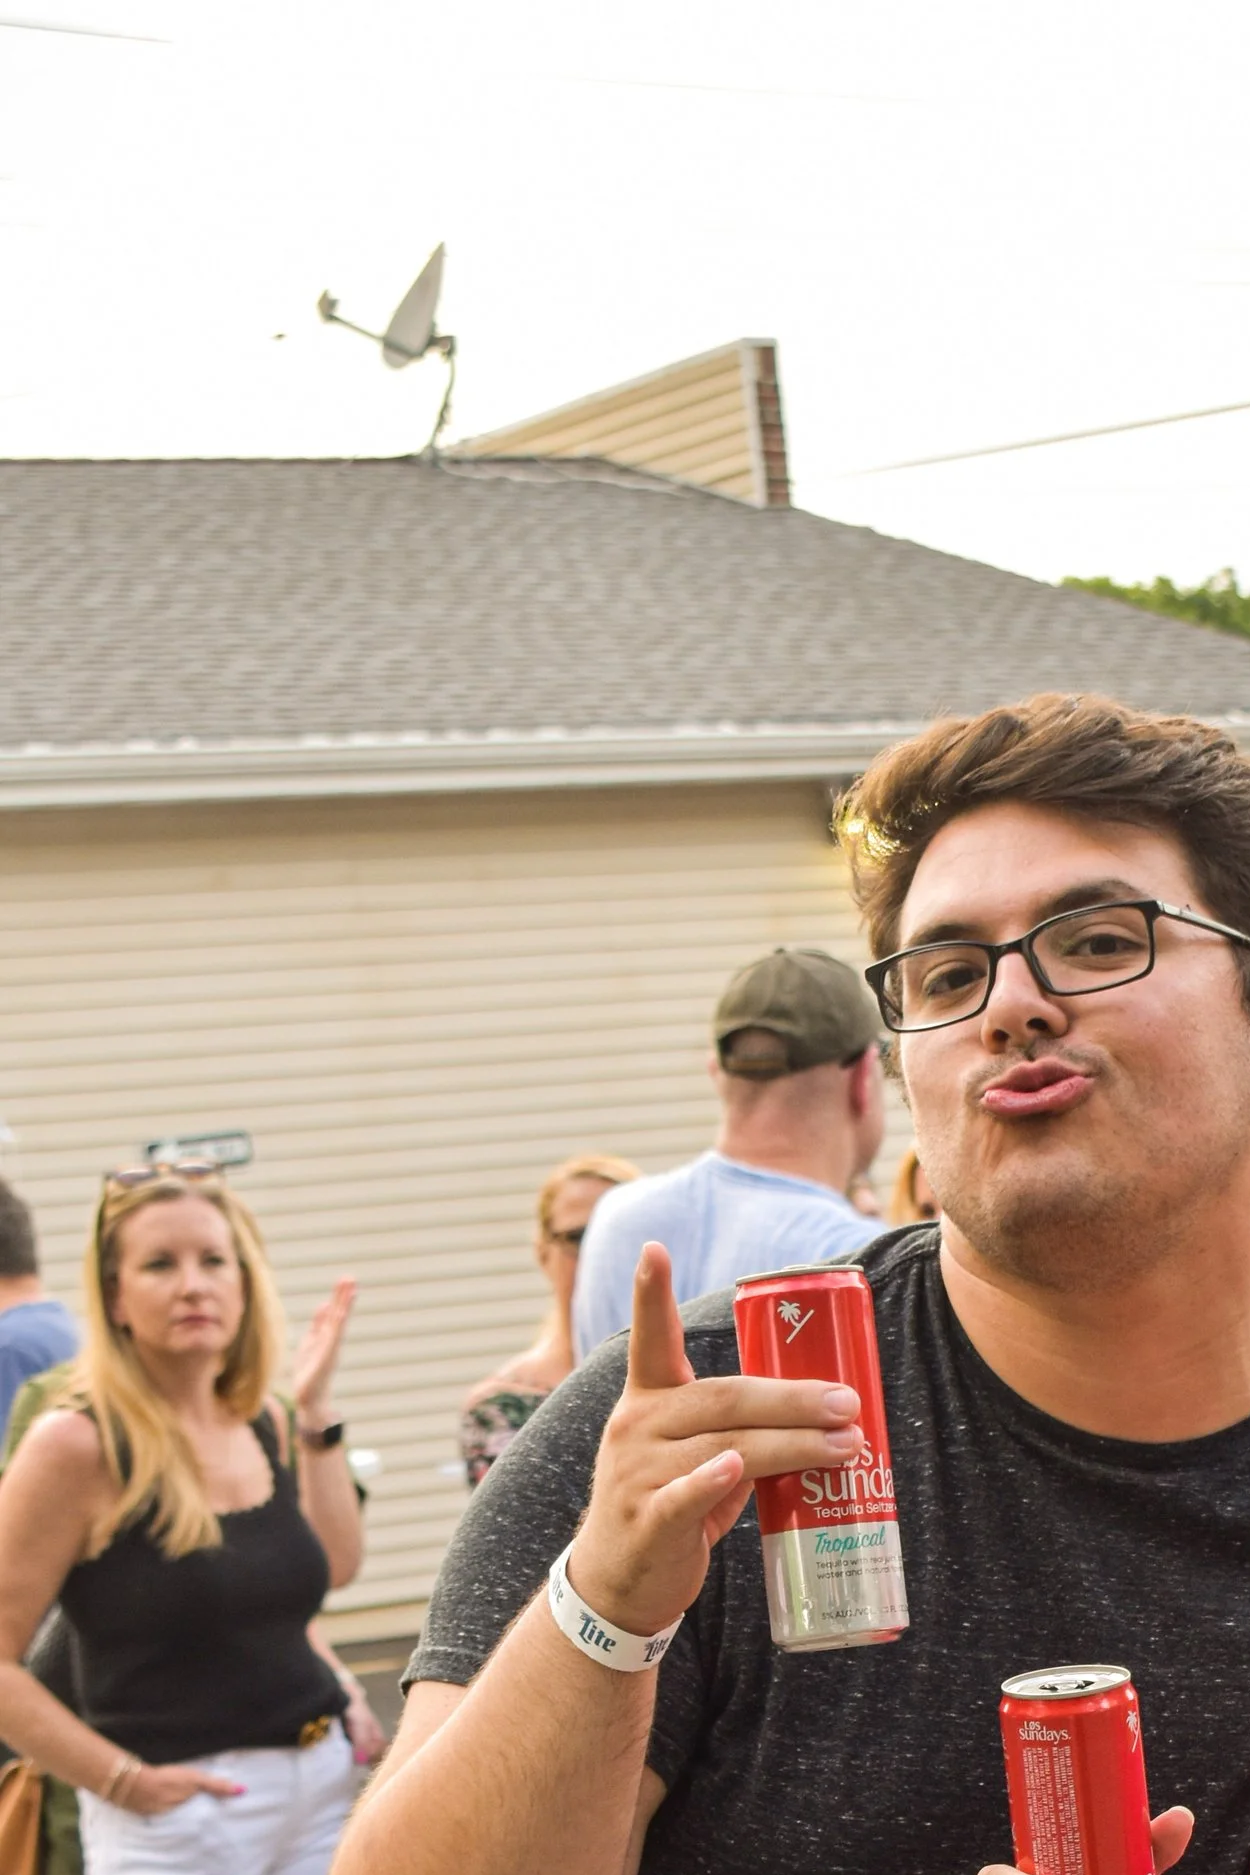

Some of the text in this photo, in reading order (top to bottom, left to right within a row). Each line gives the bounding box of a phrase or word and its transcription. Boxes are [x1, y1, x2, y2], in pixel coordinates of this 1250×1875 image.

[814, 1503, 863, 1519] Tequila
[815, 1526, 886, 1557] Tropical
[816, 1559, 849, 1570] Tequila
[817, 1571, 843, 1579] water
[845, 1569, 862, 1577] and
[579, 1613, 616, 1654] Lite
[643, 1637, 670, 1663] Lite
[1019, 1726, 1072, 1745] Sundays.
